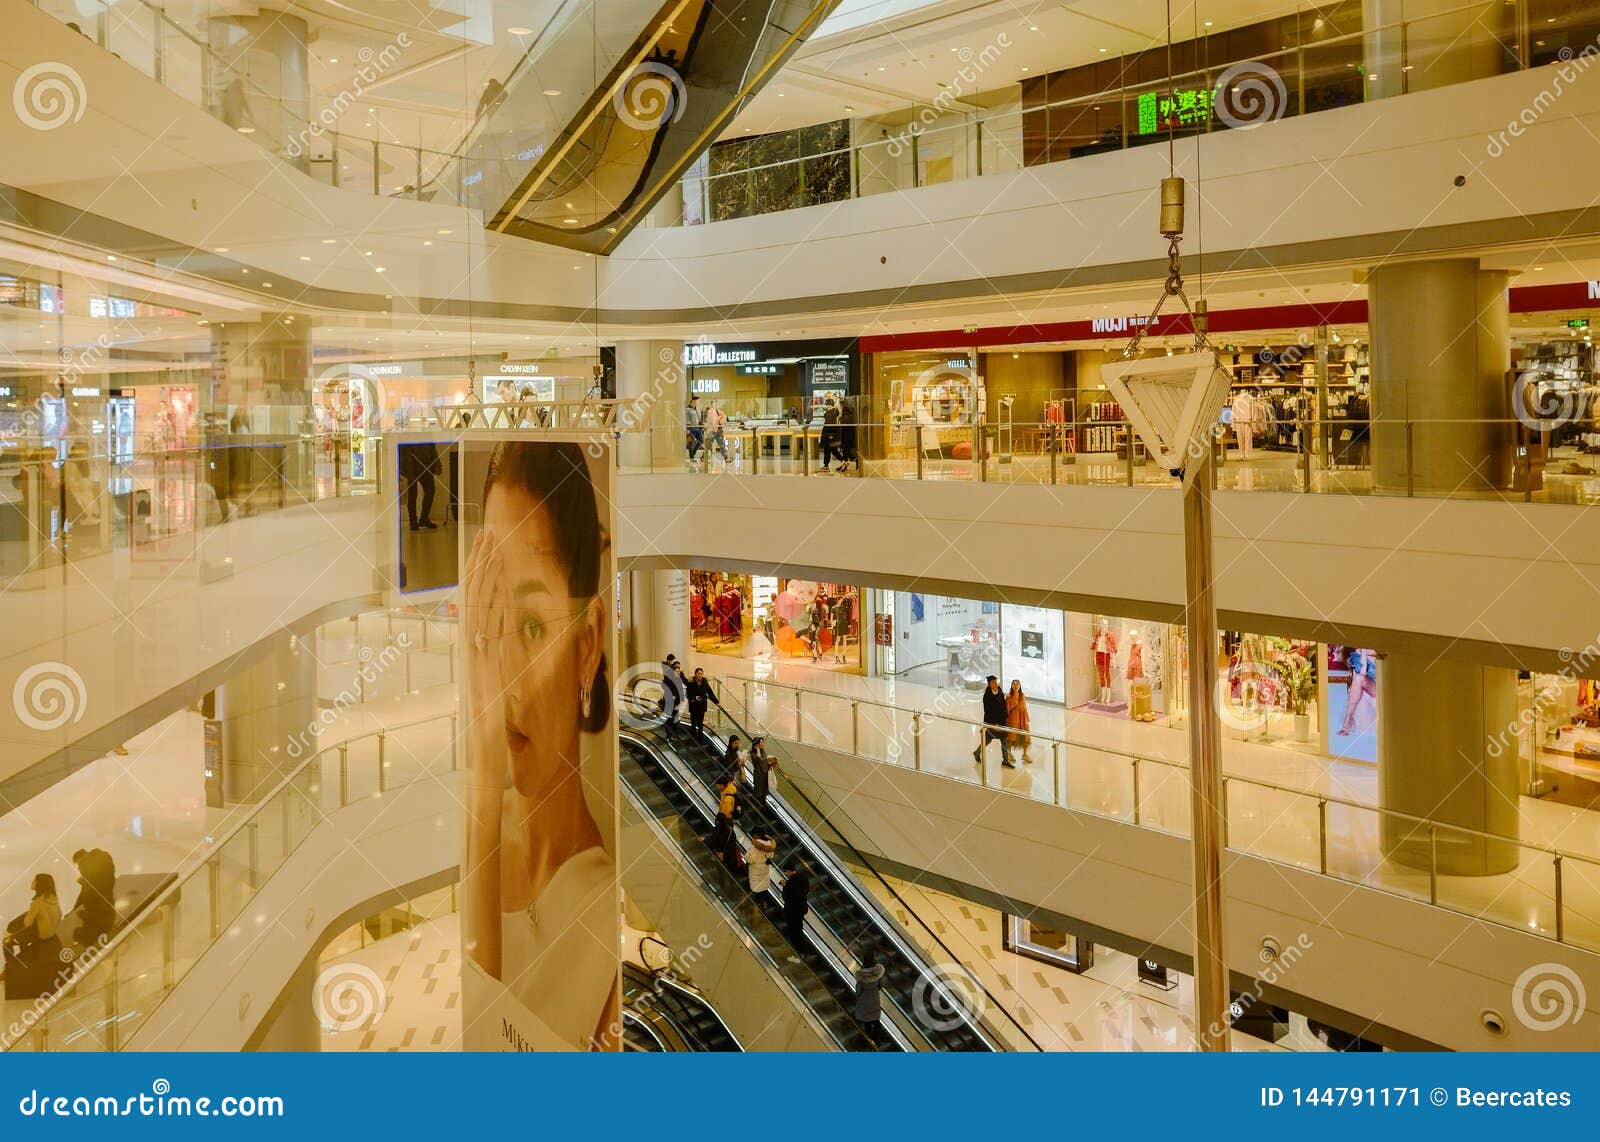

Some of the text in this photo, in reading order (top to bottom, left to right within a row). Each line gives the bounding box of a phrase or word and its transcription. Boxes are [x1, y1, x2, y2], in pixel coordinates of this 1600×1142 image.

[1092, 316, 1128, 333] MUJI
[684, 343, 756, 365] LOHO COLLECTION
[500, 365, 538, 373] CALVIN KLEIN
[691, 379, 720, 393] LOHO
